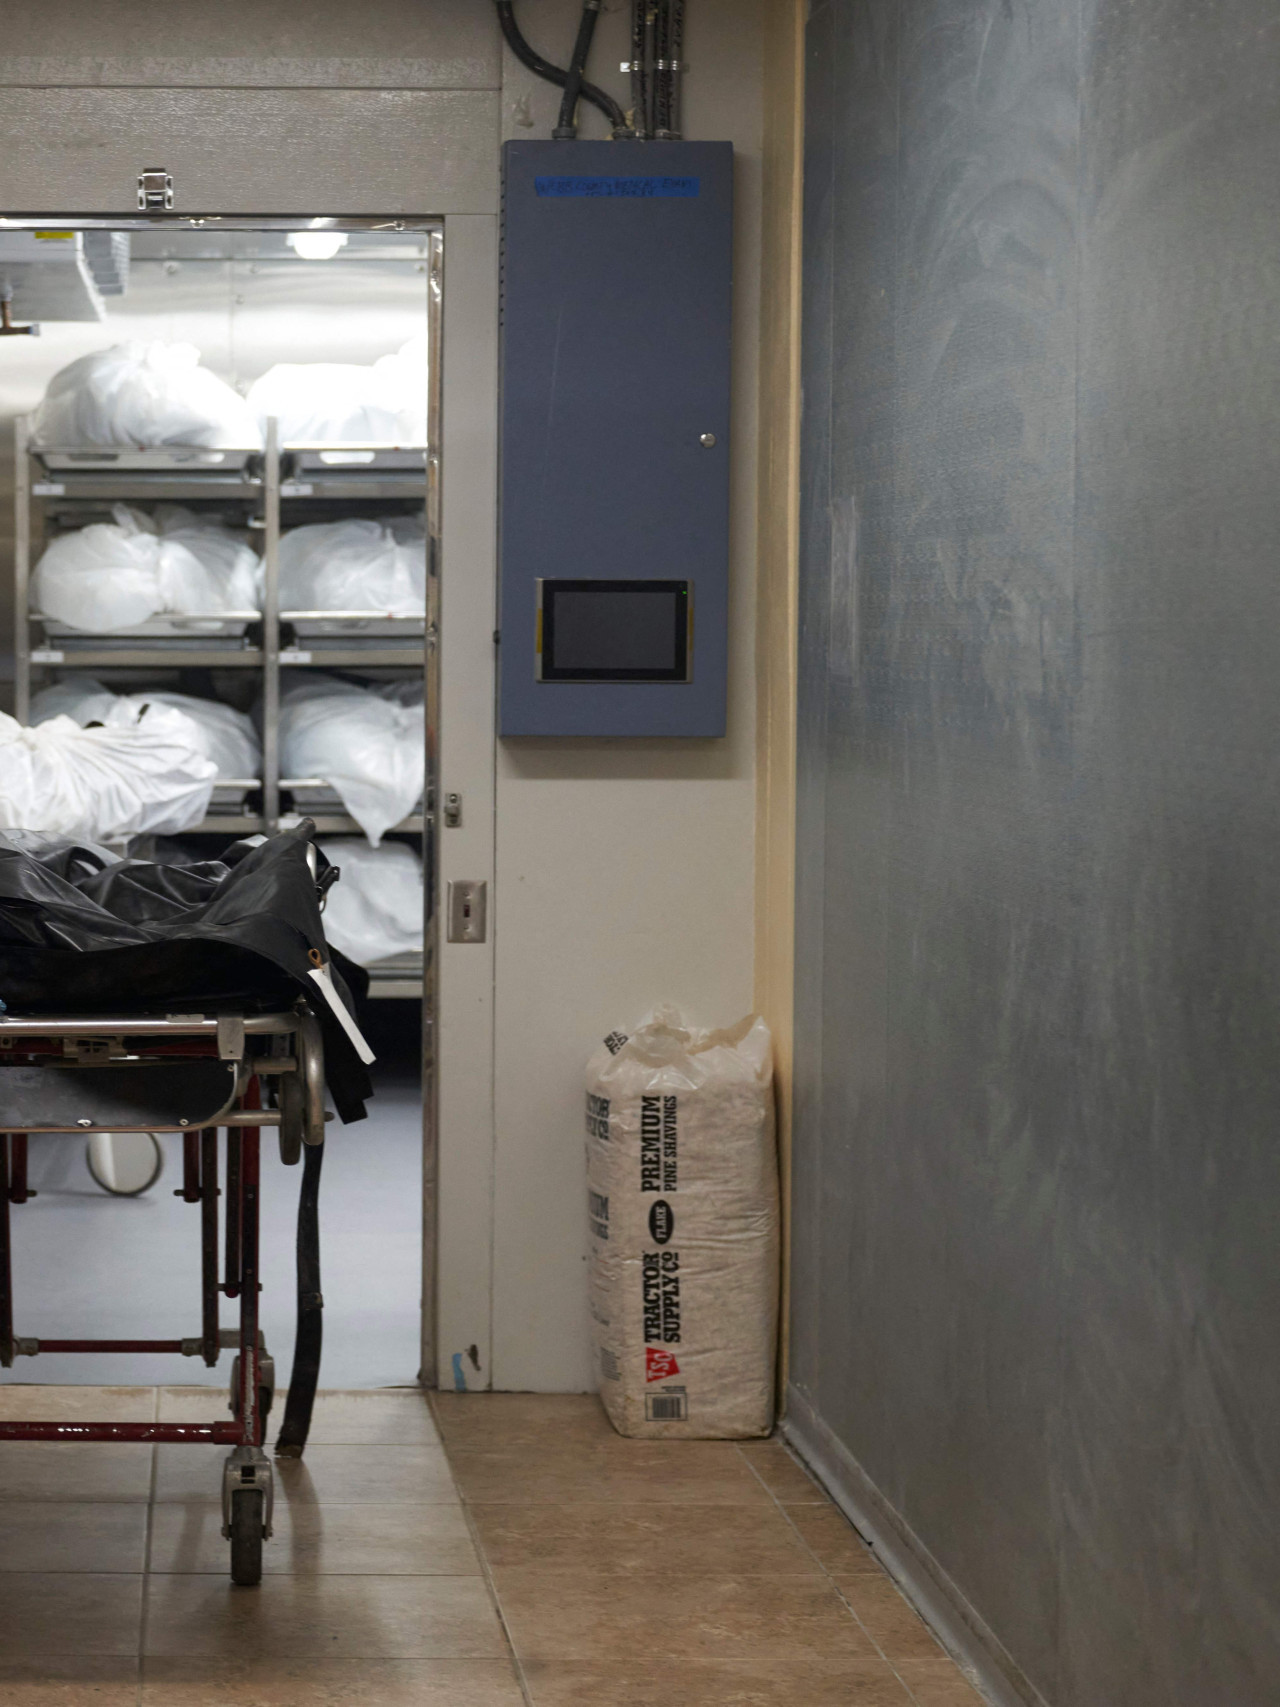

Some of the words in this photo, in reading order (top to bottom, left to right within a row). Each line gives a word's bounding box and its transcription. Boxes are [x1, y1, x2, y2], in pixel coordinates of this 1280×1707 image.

[641, 1095, 661, 1192] PREMIUM
[664, 1095, 677, 1158] SHAVINGS
[664, 1161, 677, 1192] PINE
[656, 1205, 667, 1239] FLAKE
[643, 1253, 661, 1343] TRACTOR
[662, 1274, 681, 1343] SUPPLY
